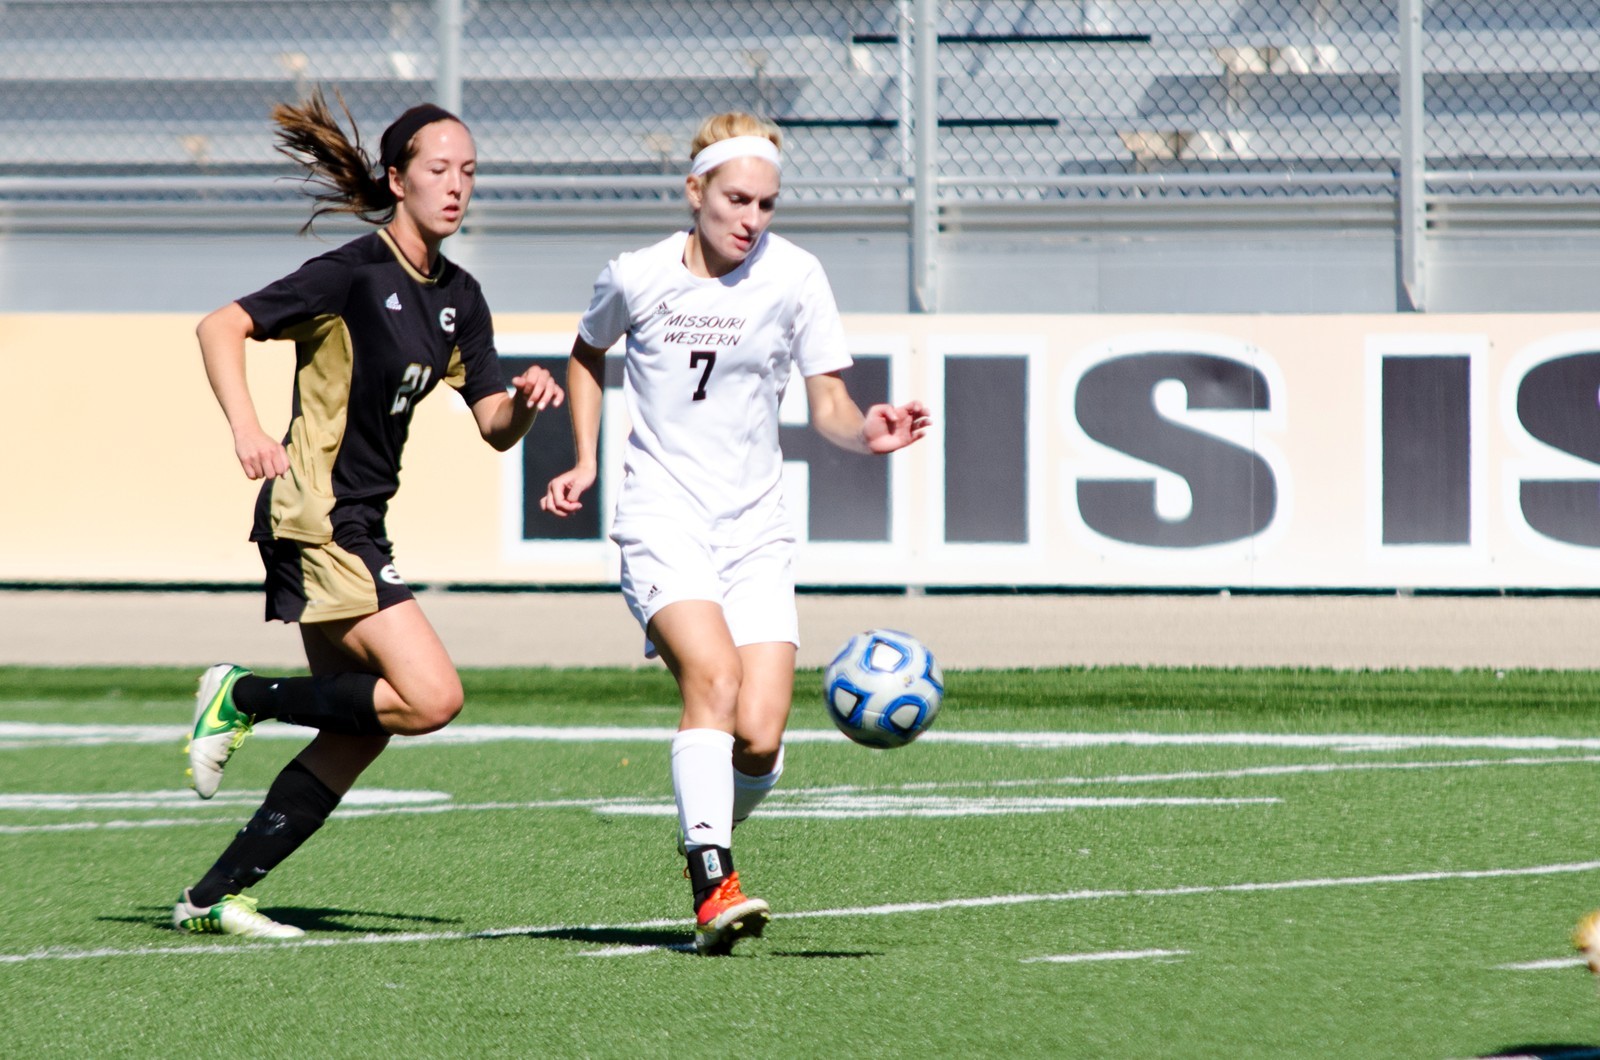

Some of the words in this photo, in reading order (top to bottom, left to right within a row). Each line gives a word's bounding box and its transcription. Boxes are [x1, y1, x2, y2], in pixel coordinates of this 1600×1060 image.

[663, 314, 747, 330] MISSOURI
[663, 331, 742, 346] WESTERN
[389, 362, 432, 415] 21
[689, 350, 717, 402] 7
